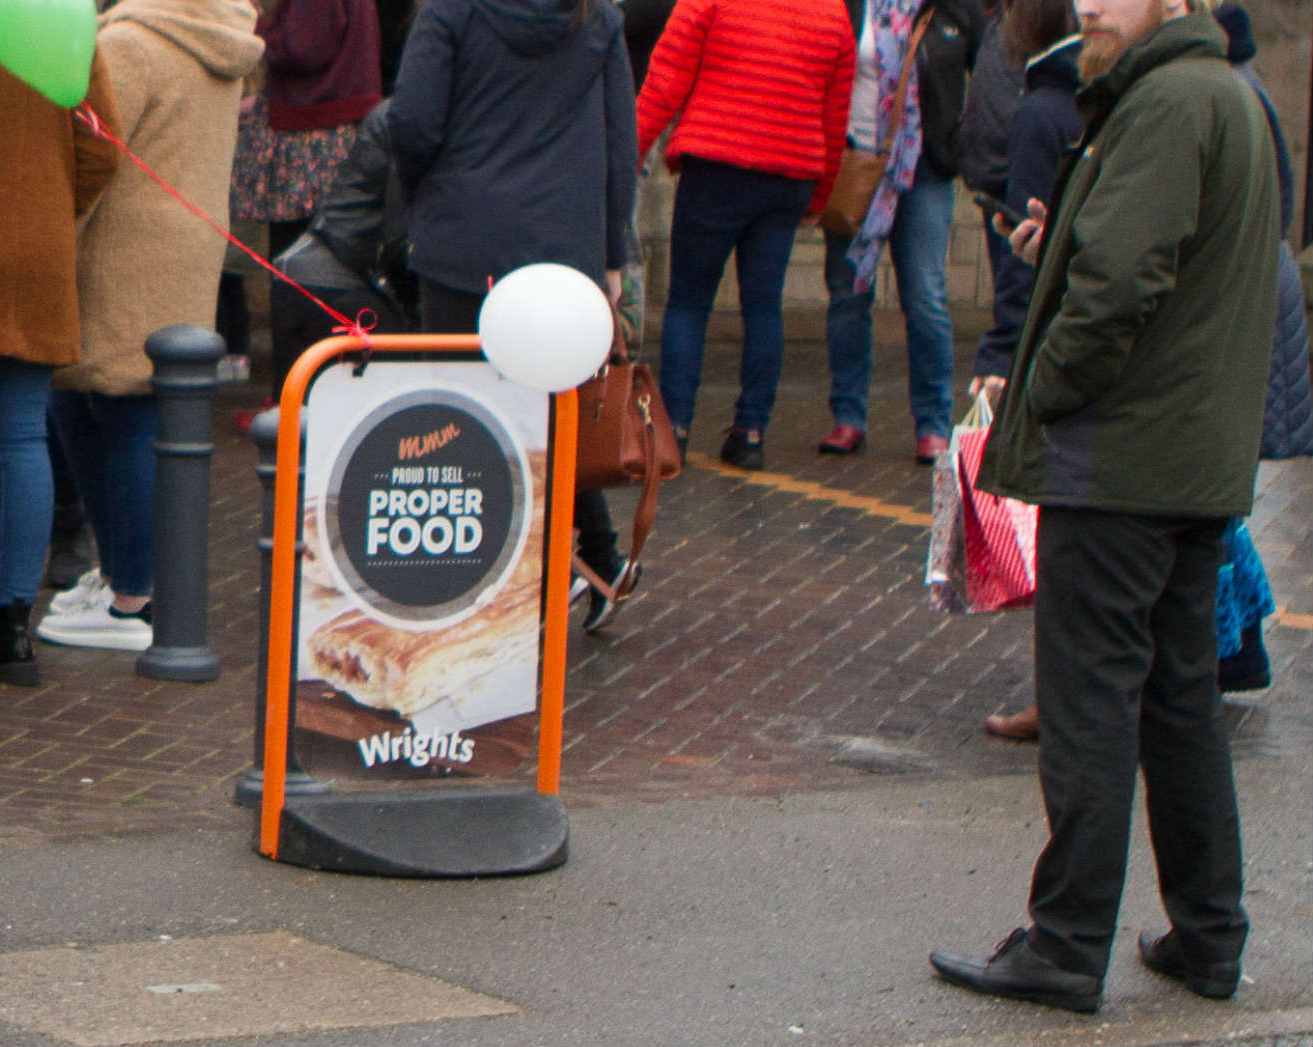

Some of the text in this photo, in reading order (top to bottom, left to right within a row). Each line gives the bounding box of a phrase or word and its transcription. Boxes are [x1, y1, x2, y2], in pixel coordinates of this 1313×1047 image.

[392, 465, 464, 484] PROUD TO SELL
[369, 488, 484, 517] PROPER
[367, 515, 484, 556] FOOD
[358, 725, 476, 769] Wrights
